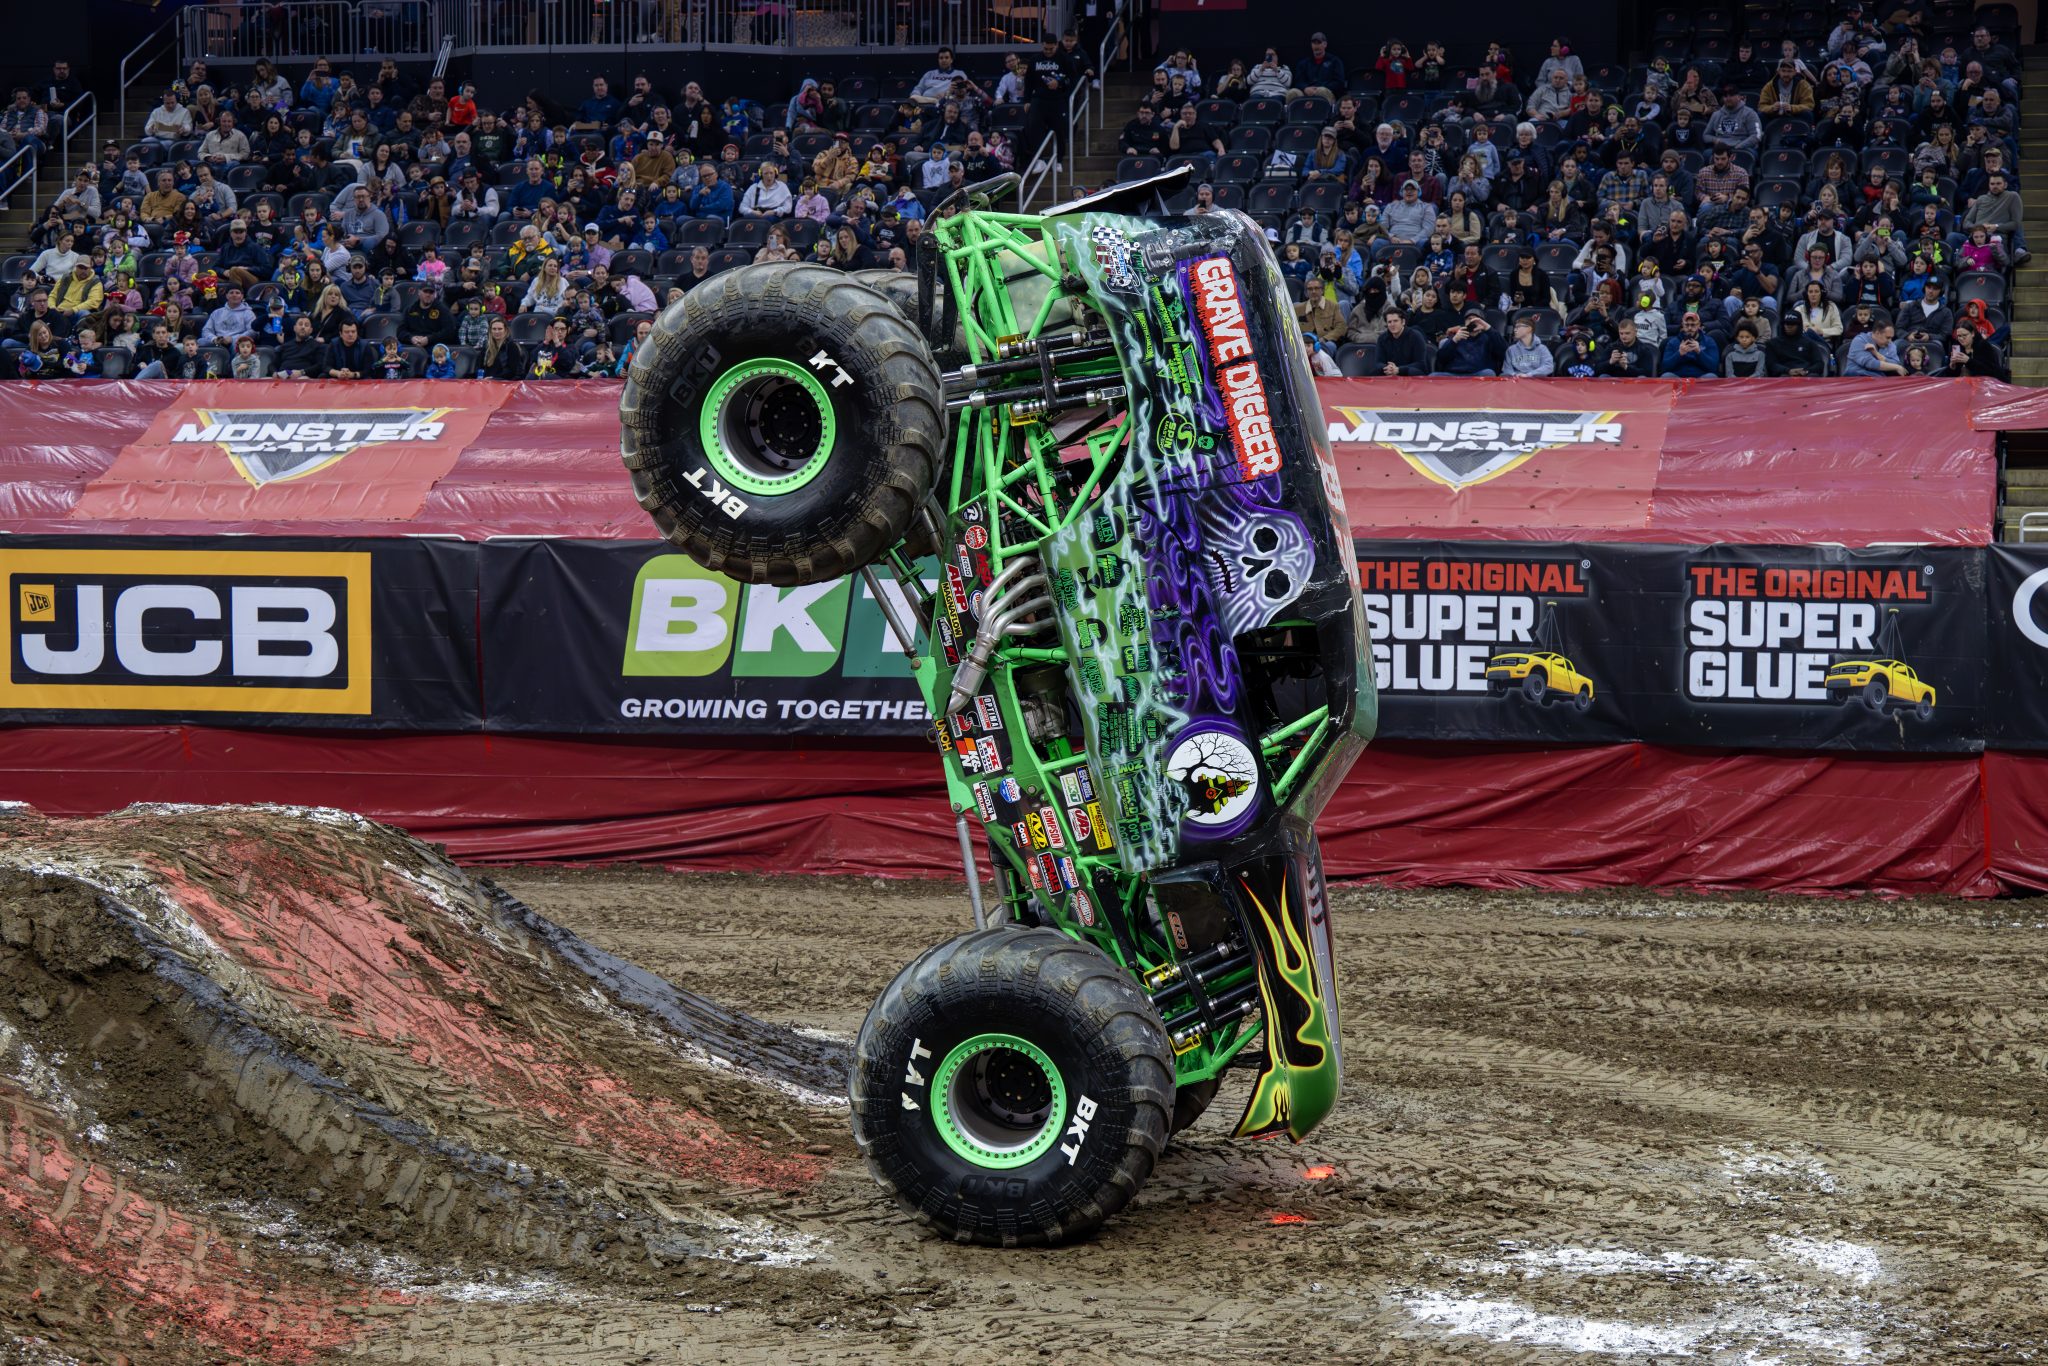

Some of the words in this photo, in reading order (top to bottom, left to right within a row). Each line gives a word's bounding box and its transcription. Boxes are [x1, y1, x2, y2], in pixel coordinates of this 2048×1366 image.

[1035, 61, 1059, 71] Modelo
[1197, 258, 1253, 361] GRAVE
[1226, 363, 1280, 476] DIGGER
[172, 422, 445, 442] MONSTER
[1163, 422, 1176, 449] SPIN
[1328, 422, 1622, 442] MONSTER
[682, 467, 749, 520] BKT
[975, 528, 984, 544] NGK
[962, 556, 972, 577] KING
[975, 553, 993, 587] MSD
[1357, 561, 1420, 590] THE
[1426, 562, 1584, 593] ORIGINAL
[946, 564, 968, 611] ARP
[1059, 568, 1079, 610] MONSTER
[1690, 567, 1758, 597] THE
[1764, 568, 1927, 600] ORIGINAL
[29, 594, 49, 612] JCB
[942, 582, 963, 637] MAGNAFLOW
[1363, 594, 1535, 643] SUPER
[20, 584, 339, 677] JCB
[1689, 600, 1876, 650] SUPER
[1124, 647, 1135, 670] Curse
[1082, 657, 1105, 695] MONSTER
[1689, 651, 1829, 700] GLUE
[620, 698, 767, 719] GROWING
[983, 697, 1000, 729] OPTIMA
[935, 718, 953, 752] UNOH
[1146, 720, 1157, 739] RIP
[979, 780, 994, 814] LINCOLN
[1018, 822, 1028, 844] Coan
[1043, 810, 1062, 844] SIMPSON
[1075, 809, 1089, 837] JAZ
[1095, 804, 1107, 833] ENERGY
[1042, 855, 1061, 892] DERALE
[1060, 1094, 1098, 1166] BKT
